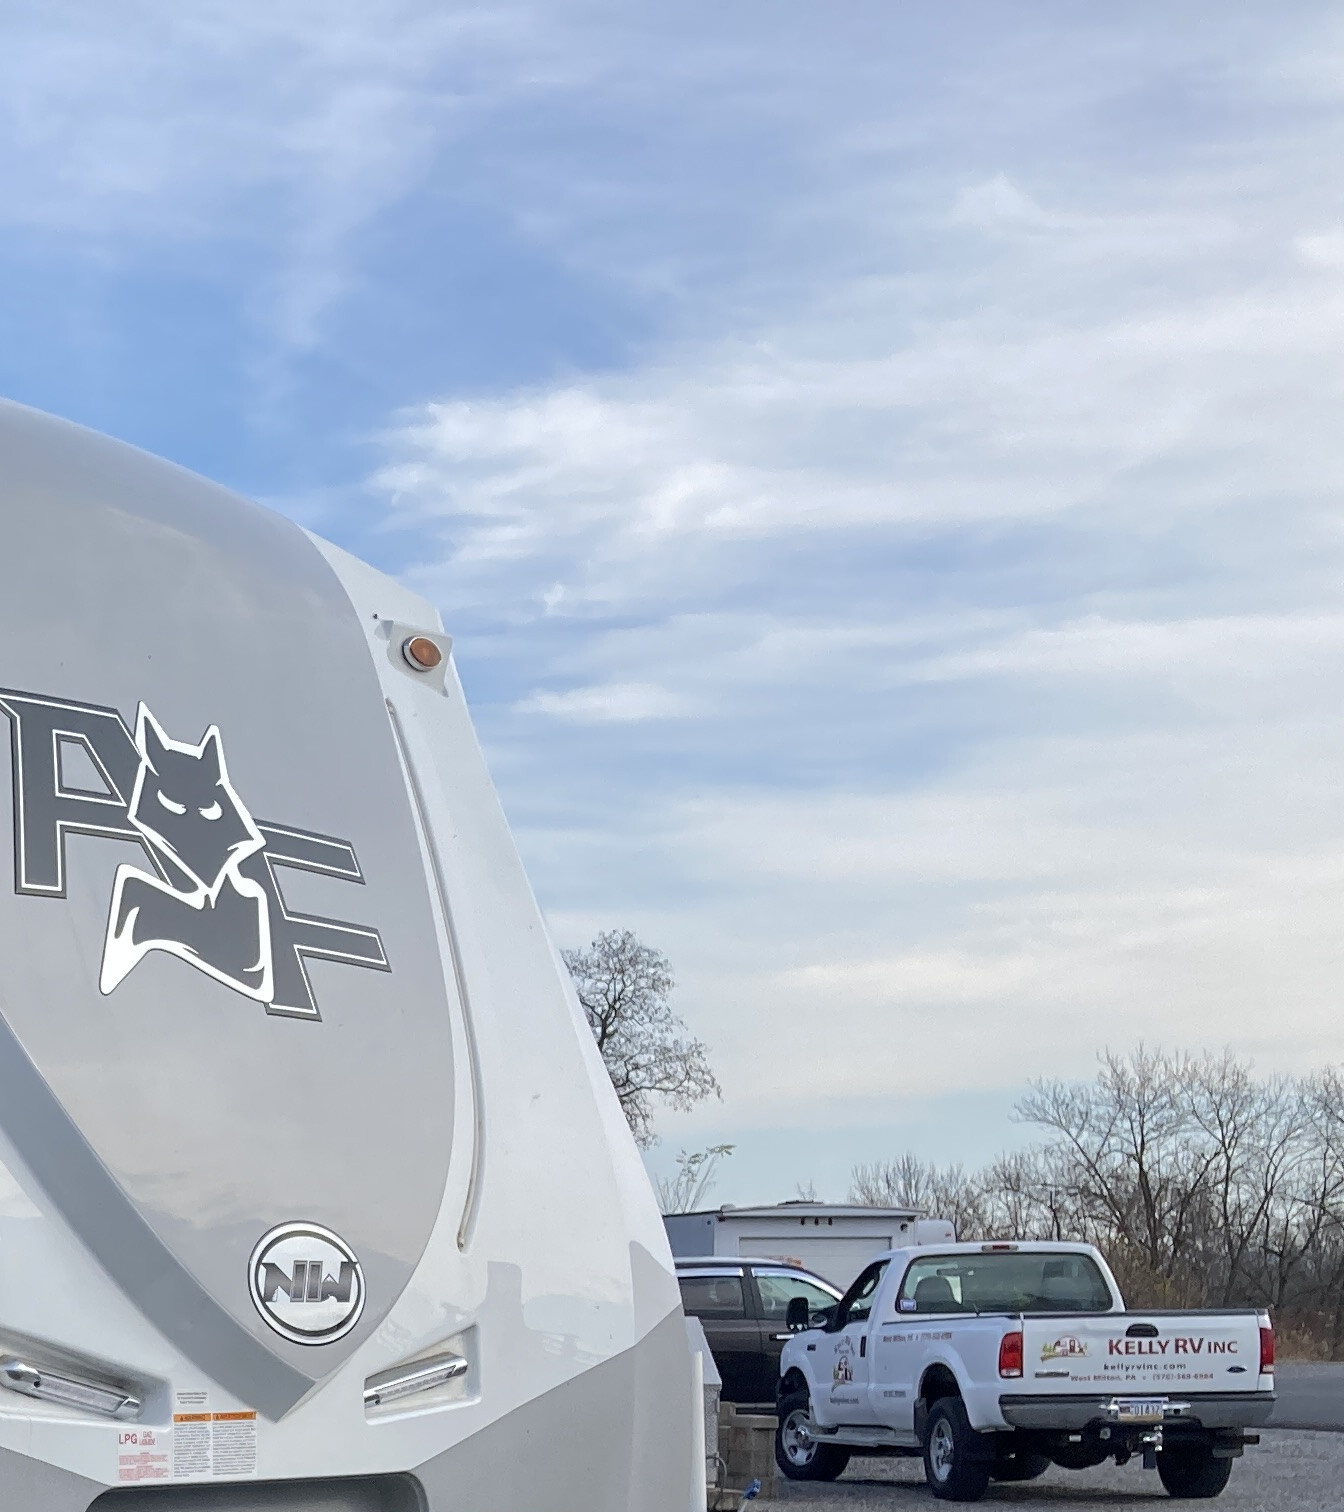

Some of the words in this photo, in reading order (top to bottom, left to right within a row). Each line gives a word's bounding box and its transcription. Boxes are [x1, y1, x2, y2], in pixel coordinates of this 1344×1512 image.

[1108, 1338, 1170, 1356] KELLY
[1174, 1337, 1204, 1354] RV
[1207, 1340, 1239, 1354] INC
[118, 1433, 138, 1445] LPG
